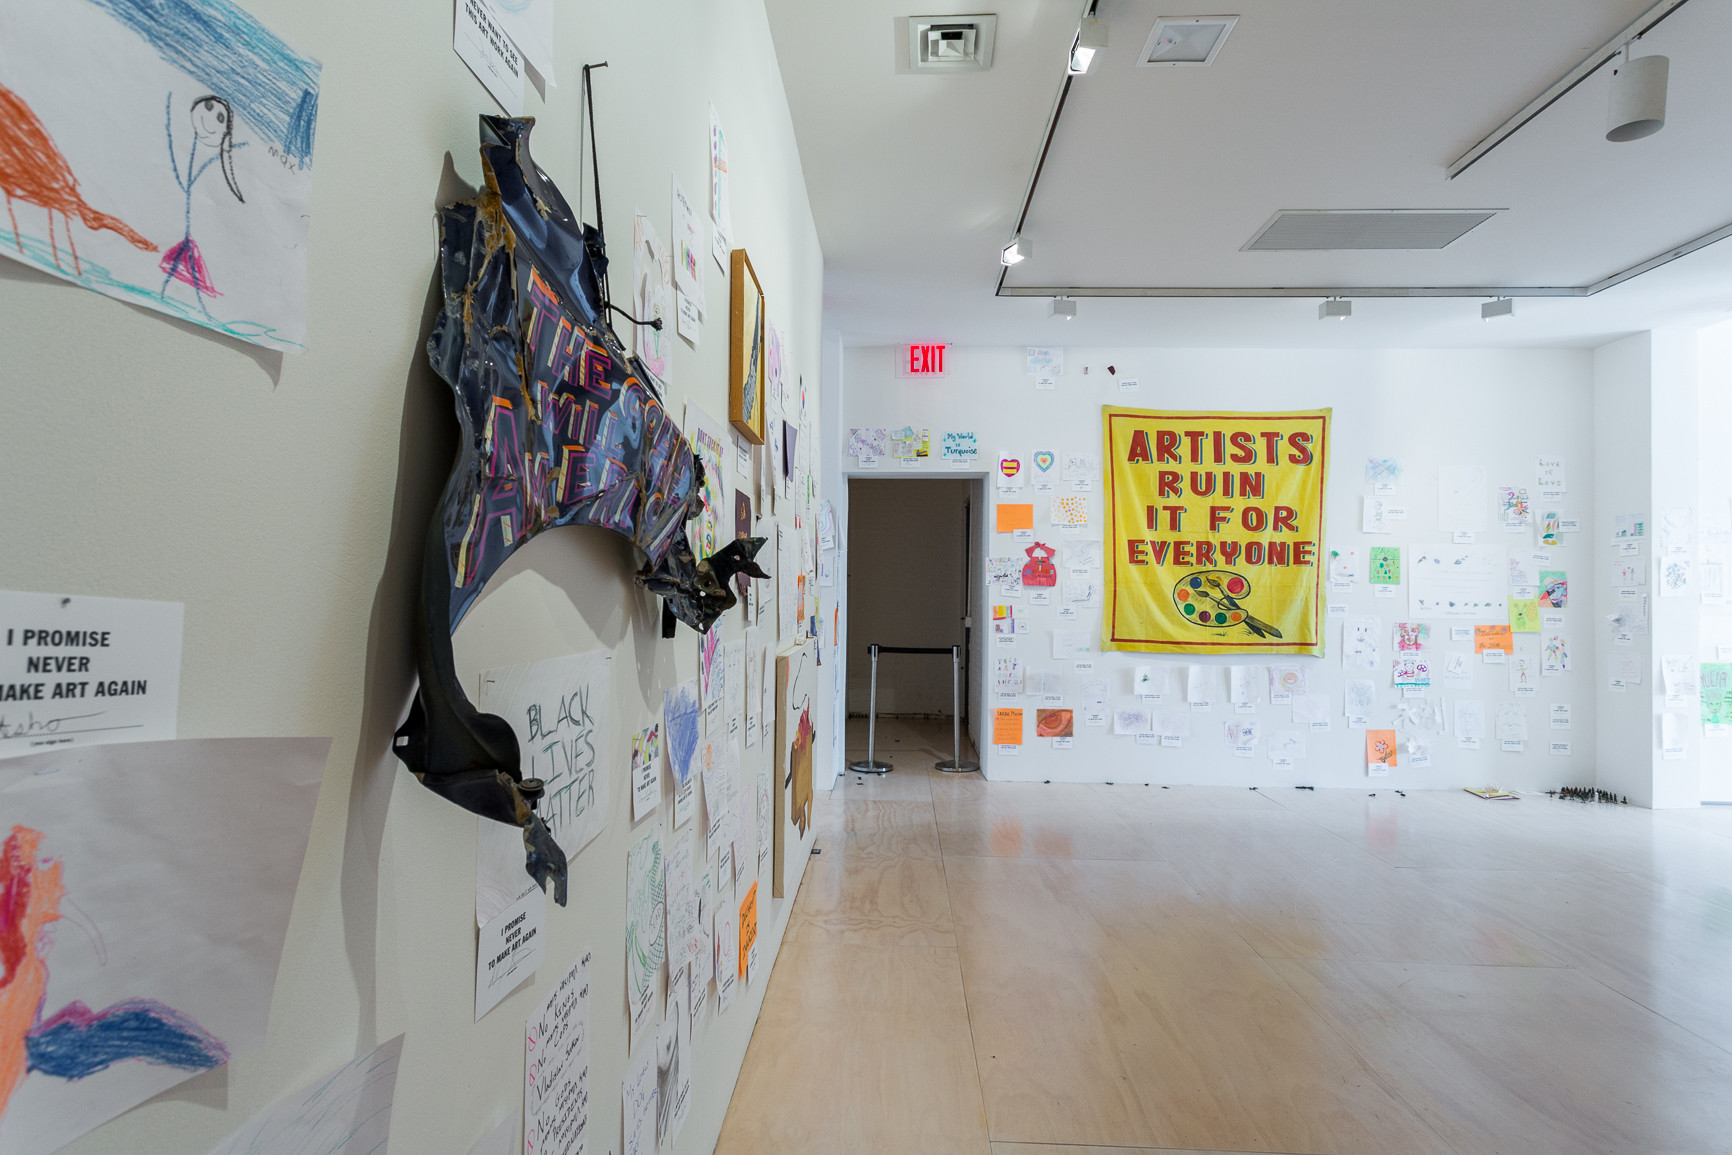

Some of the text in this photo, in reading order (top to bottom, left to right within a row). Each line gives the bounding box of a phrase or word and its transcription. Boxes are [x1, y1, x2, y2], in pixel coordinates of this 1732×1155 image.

[465, 2, 519, 79] THIS ART WORK AGAIN
[488, 20, 502, 43] WANT
[502, 39, 509, 53] TO
[509, 49, 518, 66] SEE
[527, 264, 613, 402] THE
[910, 345, 945, 373] EXIT
[536, 379, 625, 460] WILL
[947, 432, 973, 442] My World
[1127, 430, 1313, 466] ARTISTS
[945, 446, 978, 457] Turquoise
[1158, 471, 1265, 499] RUIN
[1147, 505, 1299, 533] IT FOR
[1127, 539, 1316, 567] EVERYONE
[7, 628, 111, 647] I PROMISE
[26, 656, 90, 673] NEVER
[51, 682, 89, 699] ART
[94, 680, 147, 697] AGAIN
[526, 683, 595, 743] BLACK
[504, 911, 526, 934] PROMISE
[505, 927, 521, 945] NEVER
[488, 926, 537, 971] TO MAKE ART AGAIN
